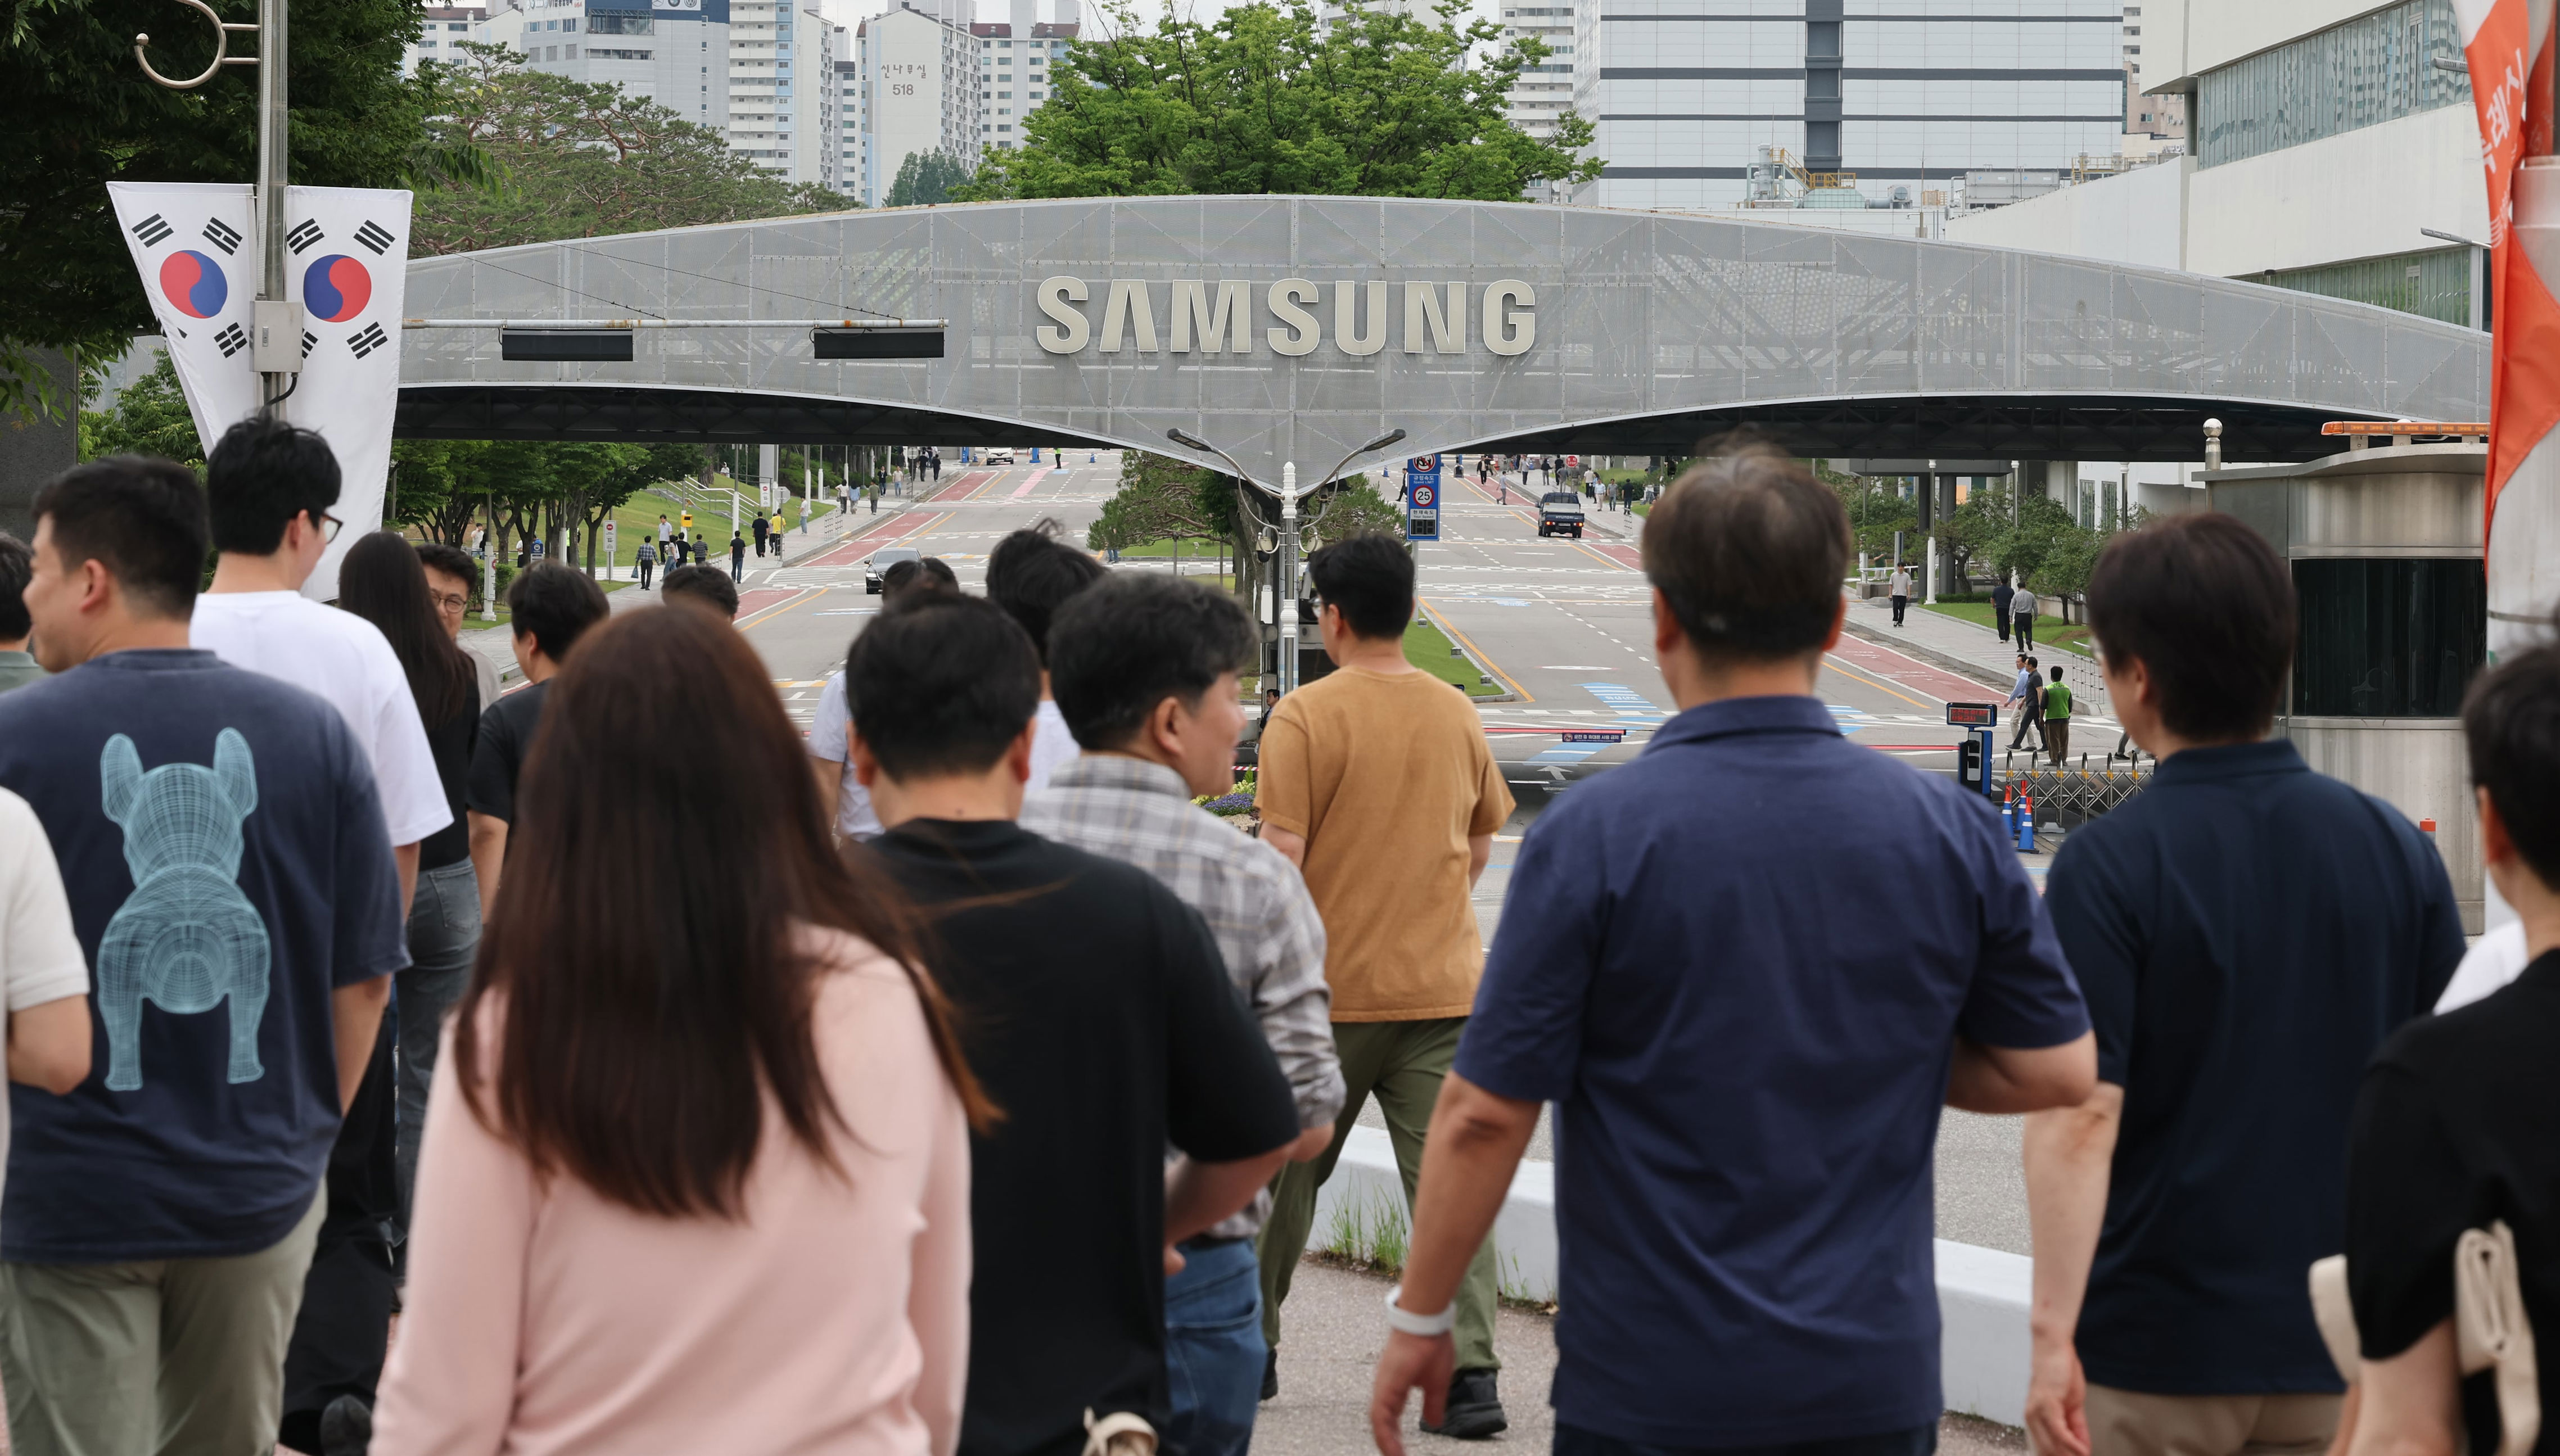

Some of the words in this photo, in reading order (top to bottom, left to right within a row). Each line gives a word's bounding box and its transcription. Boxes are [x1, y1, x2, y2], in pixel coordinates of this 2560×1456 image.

[881, 64, 926, 79] 신나무실
[892, 84, 914, 96] 518
[1036, 276, 1536, 356] SAMSUNG
[1417, 491, 1430, 500] 25
